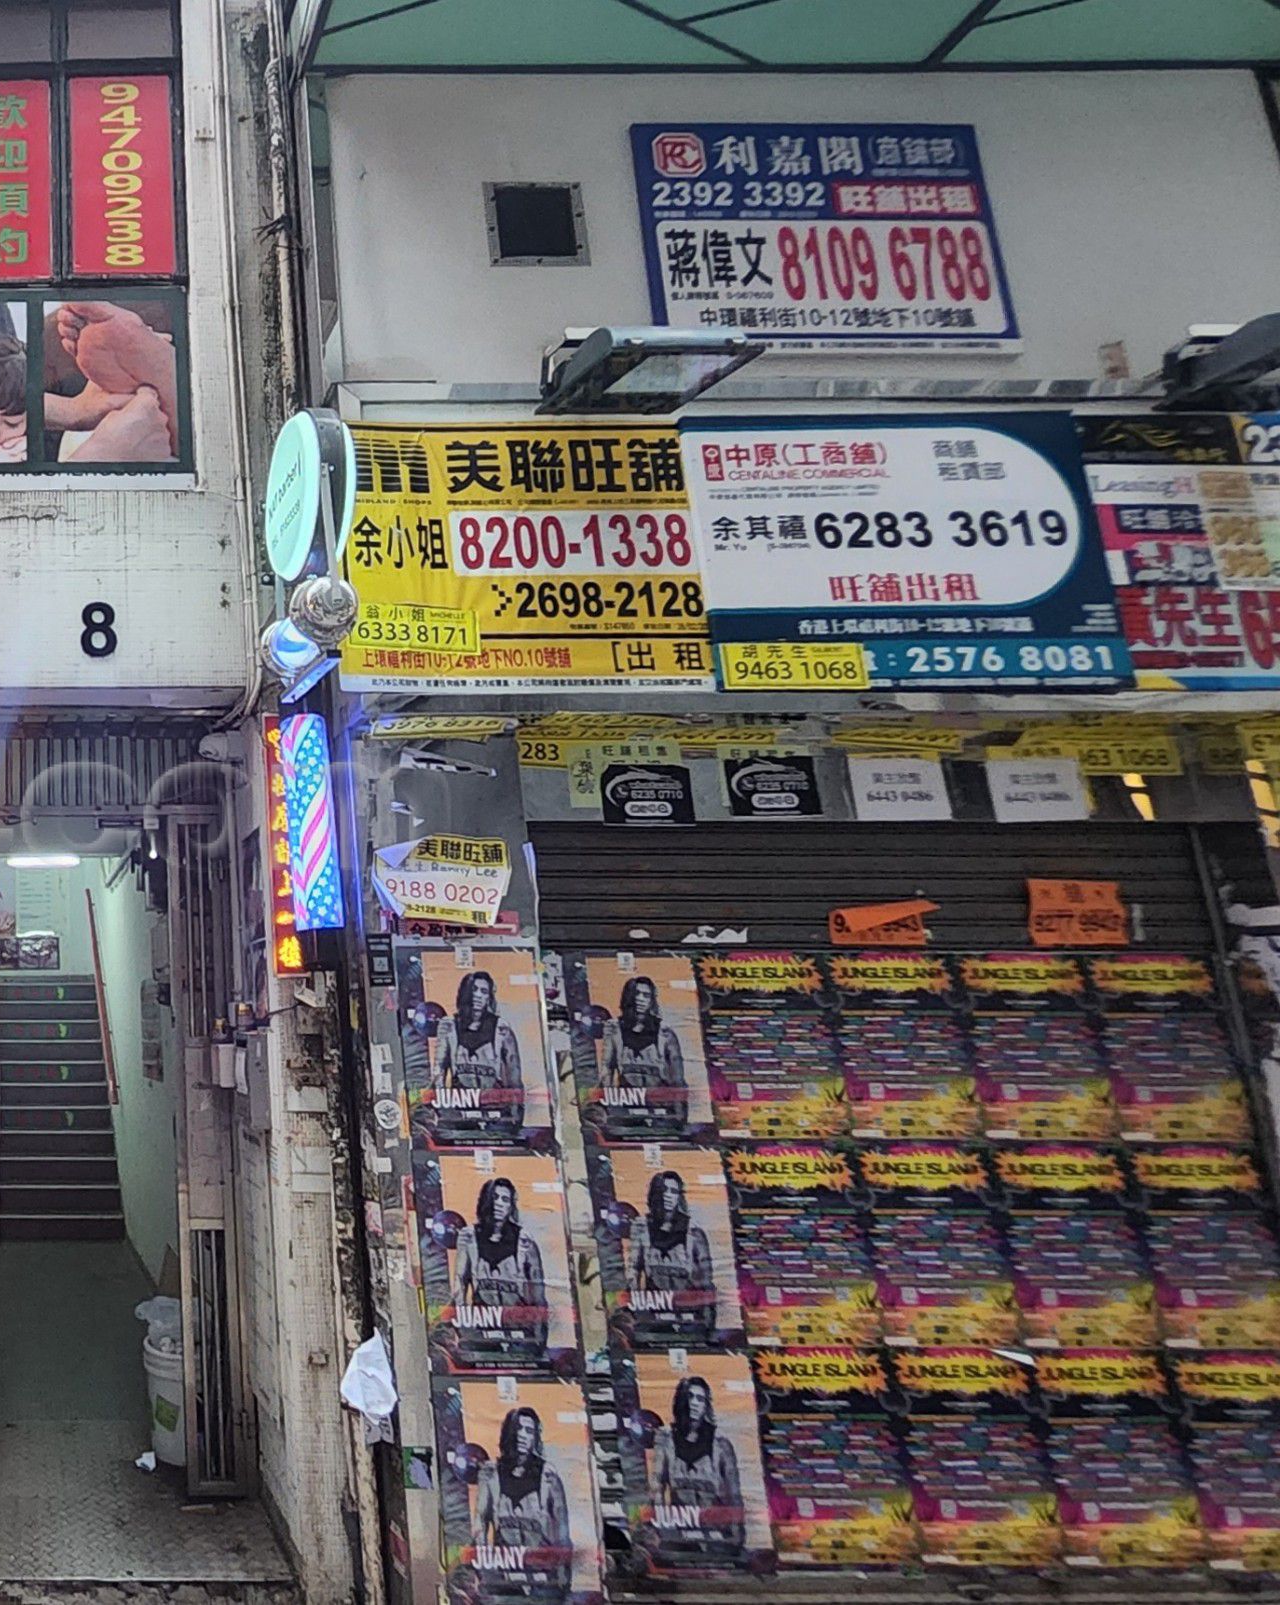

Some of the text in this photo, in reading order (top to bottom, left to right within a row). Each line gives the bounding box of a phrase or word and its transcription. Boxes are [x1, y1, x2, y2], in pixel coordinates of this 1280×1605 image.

[711, 134, 864, 176] 利嘉閣
[100, 83, 146, 267] 94709238
[651, 180, 826, 208] 2392 3392
[664, 227, 773, 289] 蔣偉文
[777, 226, 991, 302] 8109 6788
[444, 438, 687, 495] 美聯旺舖
[728, 468, 801, 482] CENTALINE
[353, 513, 692, 571] 余小姐 8200-1338
[814, 510, 933, 550] 6283
[949, 509, 1069, 547] 3619
[515, 580, 705, 619] 2698-2128
[828, 572, 982, 603] 旺舖出租
[81, 601, 118, 659] 8
[357, 620, 468, 646] 6333 8171
[734, 660, 858, 681] 9463 1068
[907, 644, 1115, 673] 2576 8081
[417, 838, 504, 864] 美聯旺舖
[386, 878, 499, 906] 9188 0202
[708, 966, 761, 979] JUNGLE
[431, 1087, 481, 1109] JUANY
[599, 1086, 646, 1107] JUANY
[738, 1161, 844, 1175] JUNGLE ISLAND
[627, 1289, 675, 1311] JUANY
[451, 1305, 503, 1329] JUANY
[765, 1363, 877, 1378] JUNGLE ISLAND
[649, 1505, 701, 1529] JUANY
[471, 1546, 525, 1570] JUANY
